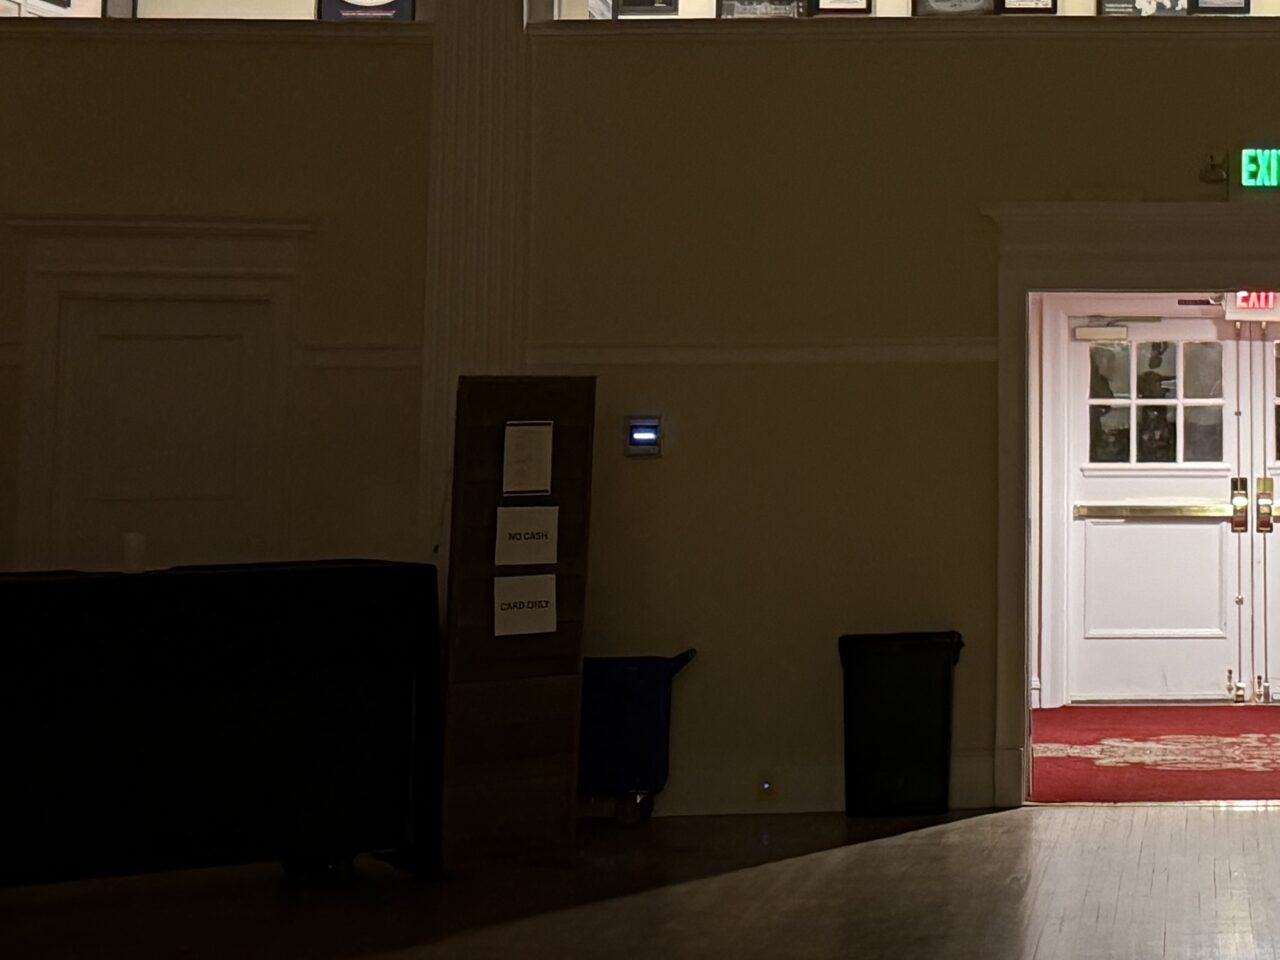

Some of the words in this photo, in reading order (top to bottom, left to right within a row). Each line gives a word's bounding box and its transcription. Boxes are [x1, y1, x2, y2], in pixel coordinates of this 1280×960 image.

[508, 532, 522, 541] NO
[523, 531, 549, 541] CASH
[500, 601, 525, 612] CARD
